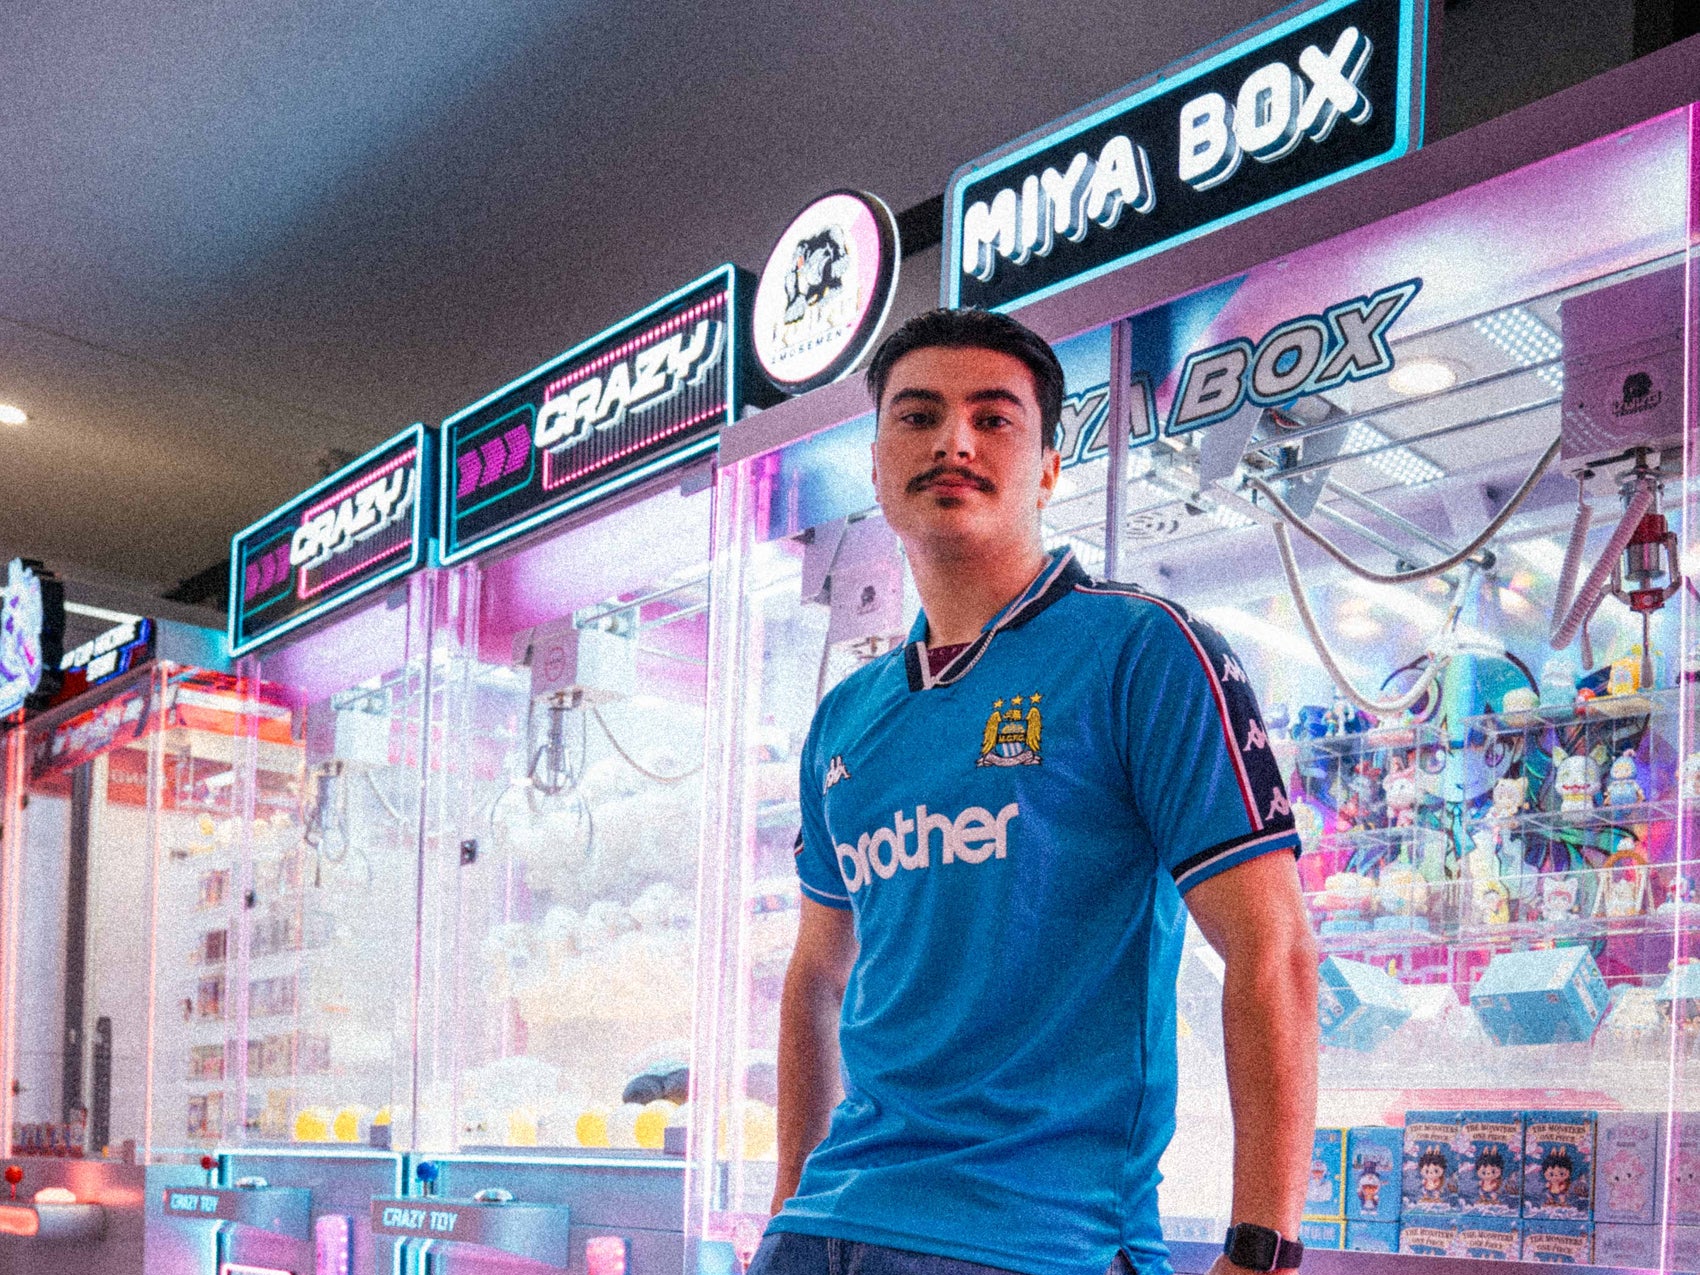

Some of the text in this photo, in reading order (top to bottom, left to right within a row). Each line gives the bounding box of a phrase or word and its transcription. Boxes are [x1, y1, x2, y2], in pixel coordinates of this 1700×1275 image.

[963, 26, 1373, 281] MIYA BOX
[534, 319, 723, 453] CRAZY
[1165, 277, 1424, 437] BOX
[290, 467, 415, 570] CRAZY
[170, 1192, 199, 1211] CRAZY
[382, 1207, 458, 1232] CRAZY TOY
